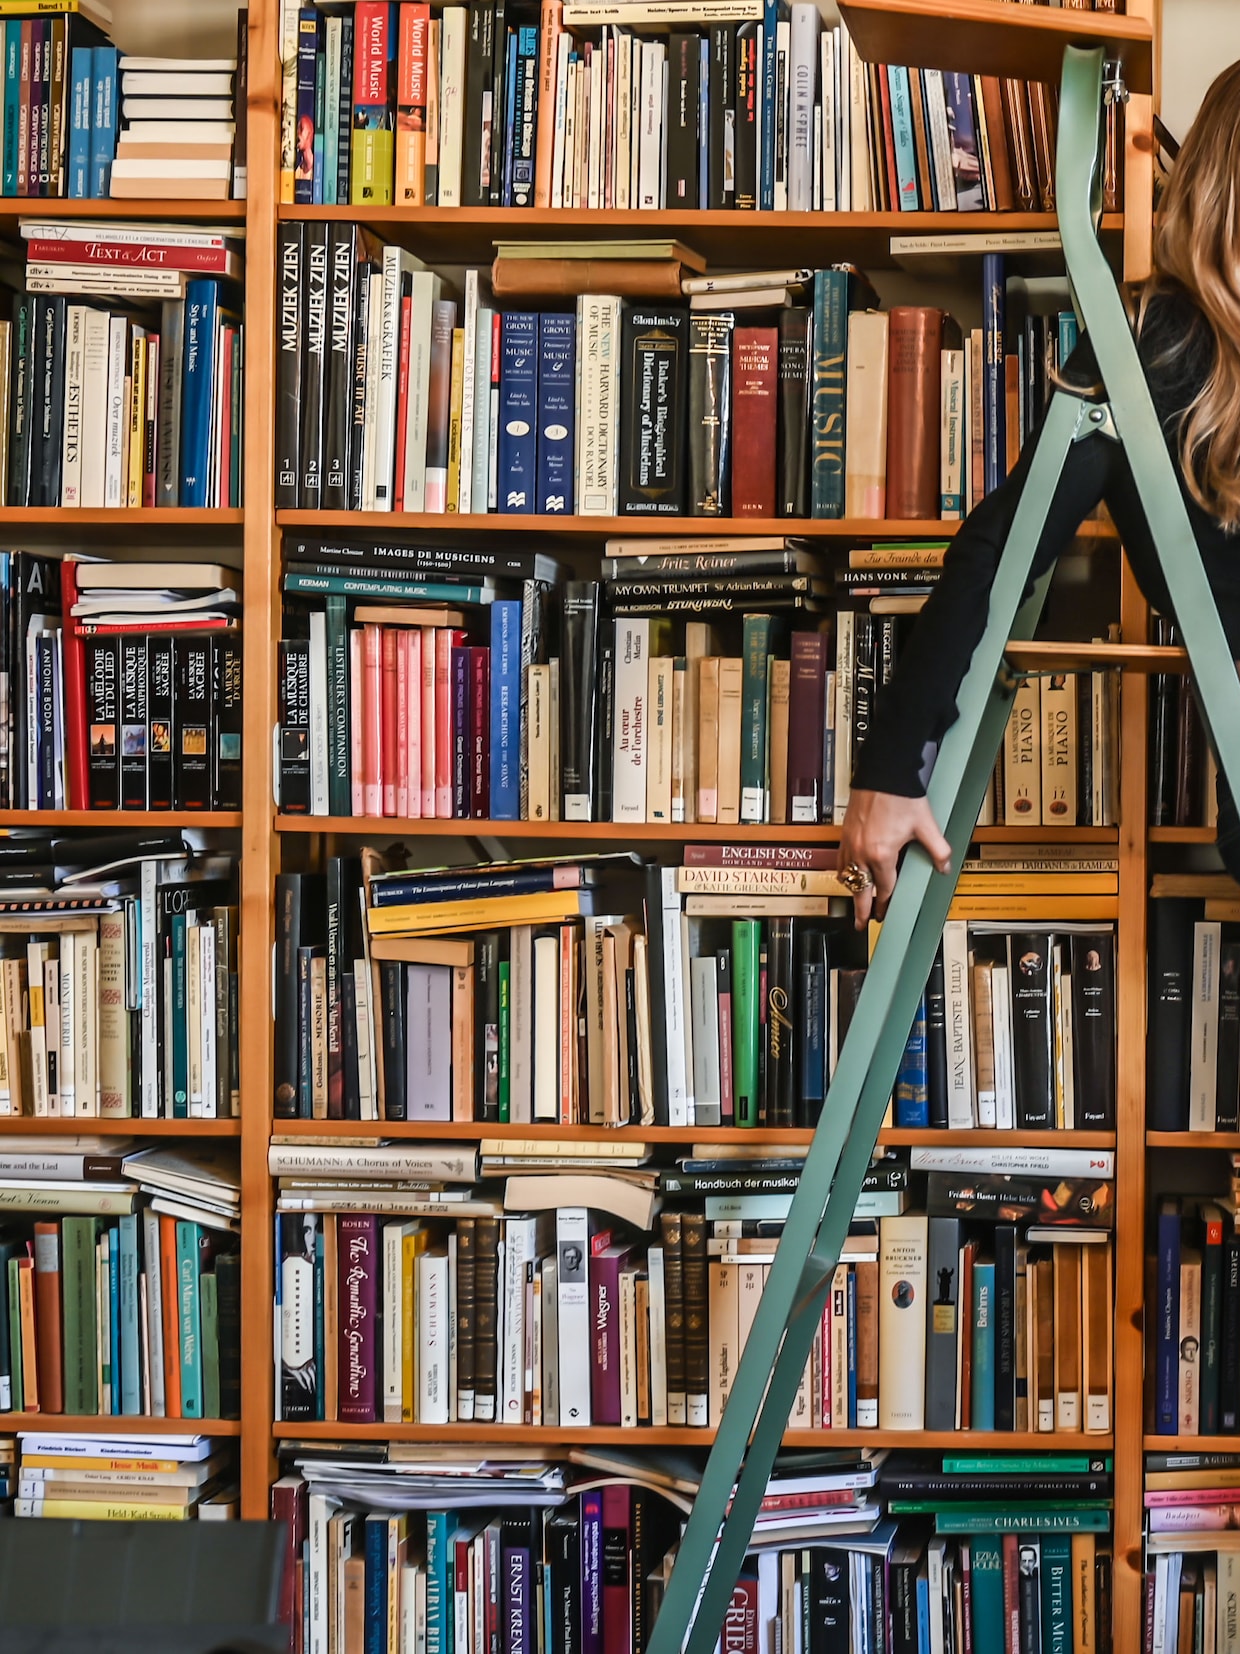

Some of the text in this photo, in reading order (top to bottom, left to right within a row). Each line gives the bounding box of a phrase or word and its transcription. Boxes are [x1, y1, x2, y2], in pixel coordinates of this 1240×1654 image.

[369, 16, 383, 99] World Music
[411, 18, 424, 100] World Music
[6, 174, 12, 182] 7
[85, 243, 122, 260] TEXT
[132, 243, 167, 263] ACT
[281, 240, 298, 352] MUZIEK ZIEN
[310, 245, 325, 353] MUZIEK ZIEN
[333, 243, 350, 352] MUZIEK ZIEN
[384, 258, 396, 308] MUZIEK
[188, 305, 199, 372] Style and Music
[506, 322, 533, 331] GROVE
[588, 305, 598, 361] OF MUSIC
[633, 314, 681, 328] Slonimsky
[381, 320, 393, 381] GRAFIEK
[506, 348, 532, 356] MUSIC
[597, 305, 612, 490] THE NEW HARVARD DICTIONARY
[639, 352, 654, 486] Dictionary of Musicians
[655, 360, 668, 477] Baker's Biographical
[815, 351, 844, 476] MUSIC
[283, 459, 289, 468] 1
[309, 461, 316, 470] 2
[333, 459, 339, 469] 3
[374, 547, 496, 564] IMAGES DE MUSICIENS
[657, 556, 736, 570] Fritz Reiner
[844, 572, 908, 582] HANS VONK
[299, 578, 428, 595] KERMAN CONTEMPLATING MUSIC
[616, 581, 774, 595] MY OWN TRUMPET Sir Adrian Boult
[43, 648, 52, 733] ANTOINE BODAR
[105, 651, 115, 718] ET DU LIED
[126, 647, 136, 718] LA MUSIQUE
[138, 647, 146, 719] SYMPHONIQUE
[287, 653, 296, 725] LA MUSIQUE
[298, 653, 307, 724] DE CHAMBRE
[96, 708, 105, 722] LA
[336, 648, 346, 779] LISTENER'S COMPANION
[631, 697, 643, 766] de l'orchestre
[1020, 707, 1033, 764] PIANO
[619, 736, 630, 752] Au
[684, 869, 798, 885] DAVID STARKEY
[722, 846, 812, 862] ENGLISH SONG
[62, 972, 70, 1048] MONTEVERDI
[952, 959, 967, 1091] JEAN-BAPTISTE LULLY
[278, 1156, 433, 1170] SCHUMANN: A Chorus of Voices
[342, 1220, 370, 1228] ROSEN
[345, 1236, 367, 1399] The Romantic Generation
[598, 1283, 610, 1330] Wagner
[977, 1287, 988, 1328] Brahms
[995, 1516, 1080, 1527] CHARLES IVES
[973, 1561, 1002, 1570] POUND
[976, 1552, 999, 1561] EZRA
[746, 1608, 754, 1649] EDVARD
[1227, 1591, 1236, 1639] SCRIABIN
